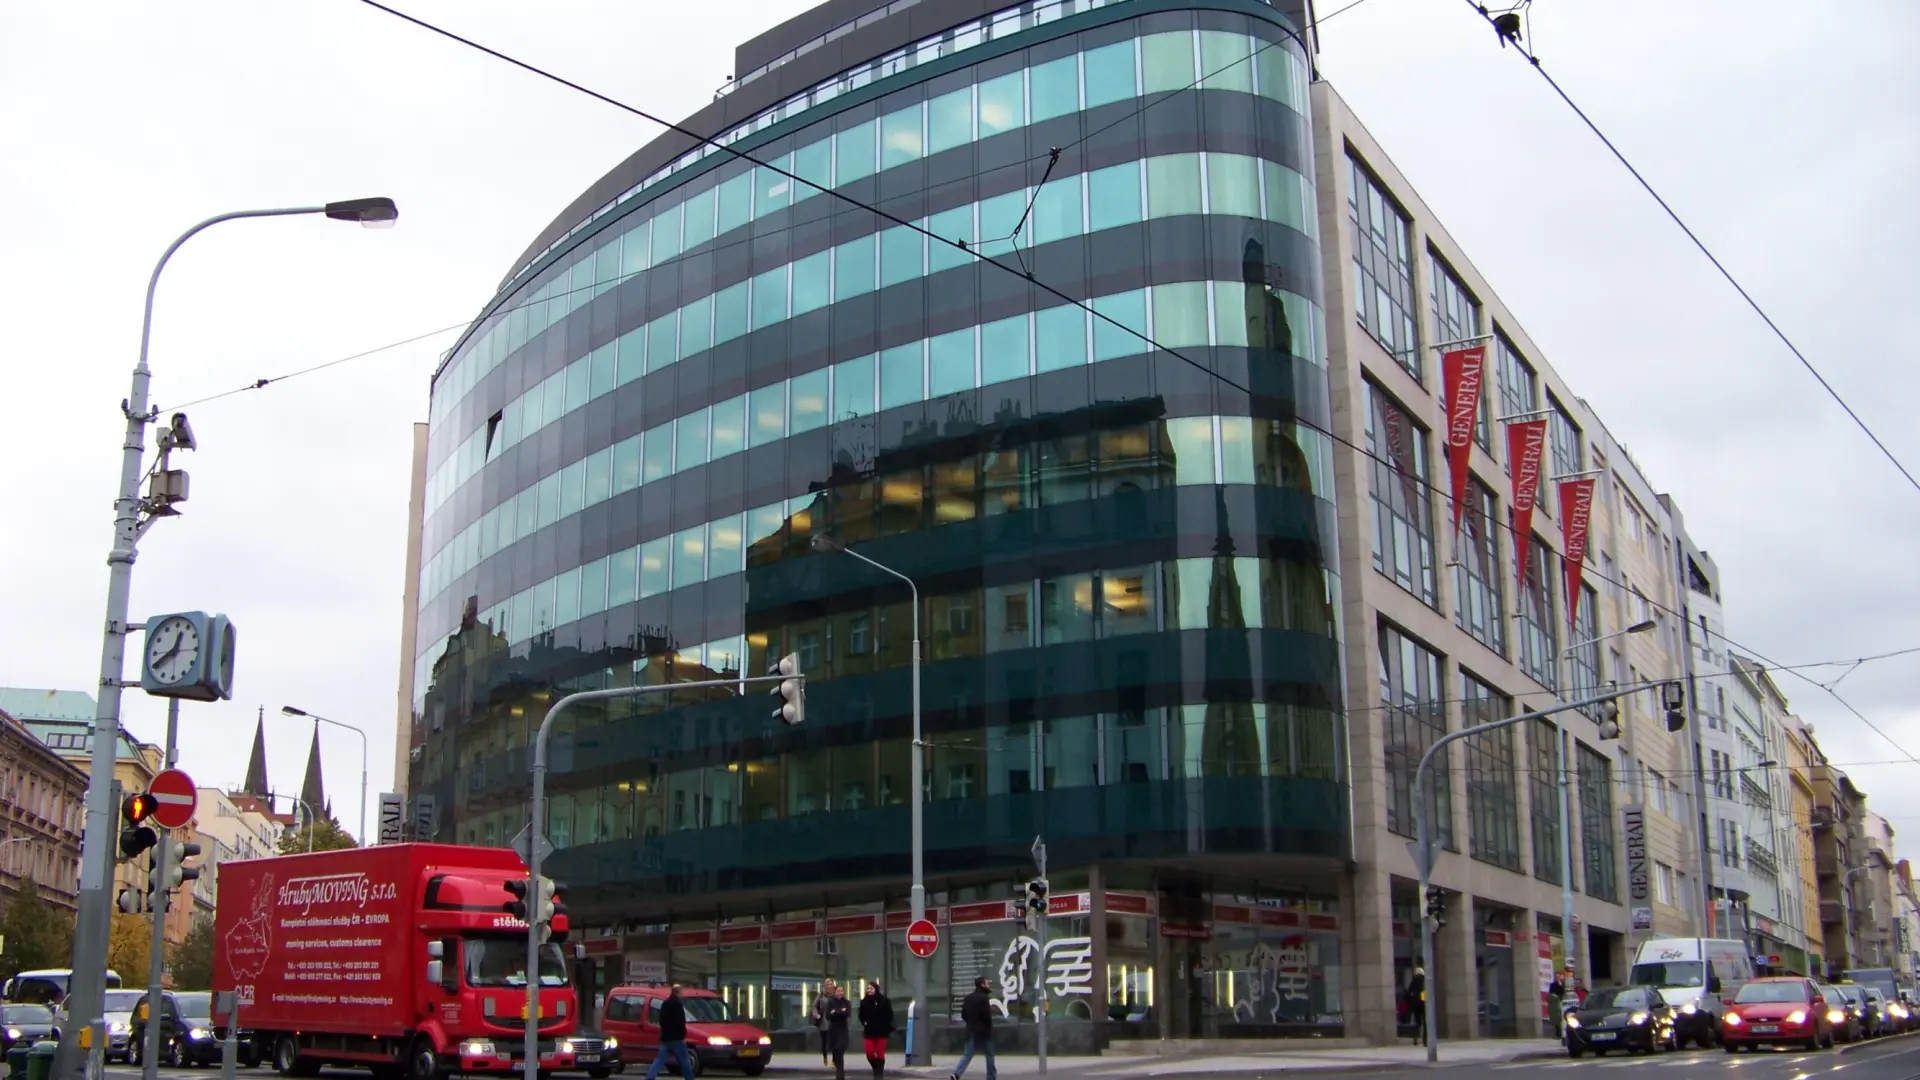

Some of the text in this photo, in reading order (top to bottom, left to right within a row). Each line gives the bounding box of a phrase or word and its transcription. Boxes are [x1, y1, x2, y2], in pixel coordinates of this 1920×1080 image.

[1451, 353, 1482, 448] GENERALI
[1516, 425, 1544, 512] GENERALI
[1568, 484, 1593, 563] GENERALI
[381, 800, 400, 845] RALI
[1626, 811, 1648, 900] GENERALI
[365, 914, 389, 925] EVROPA
